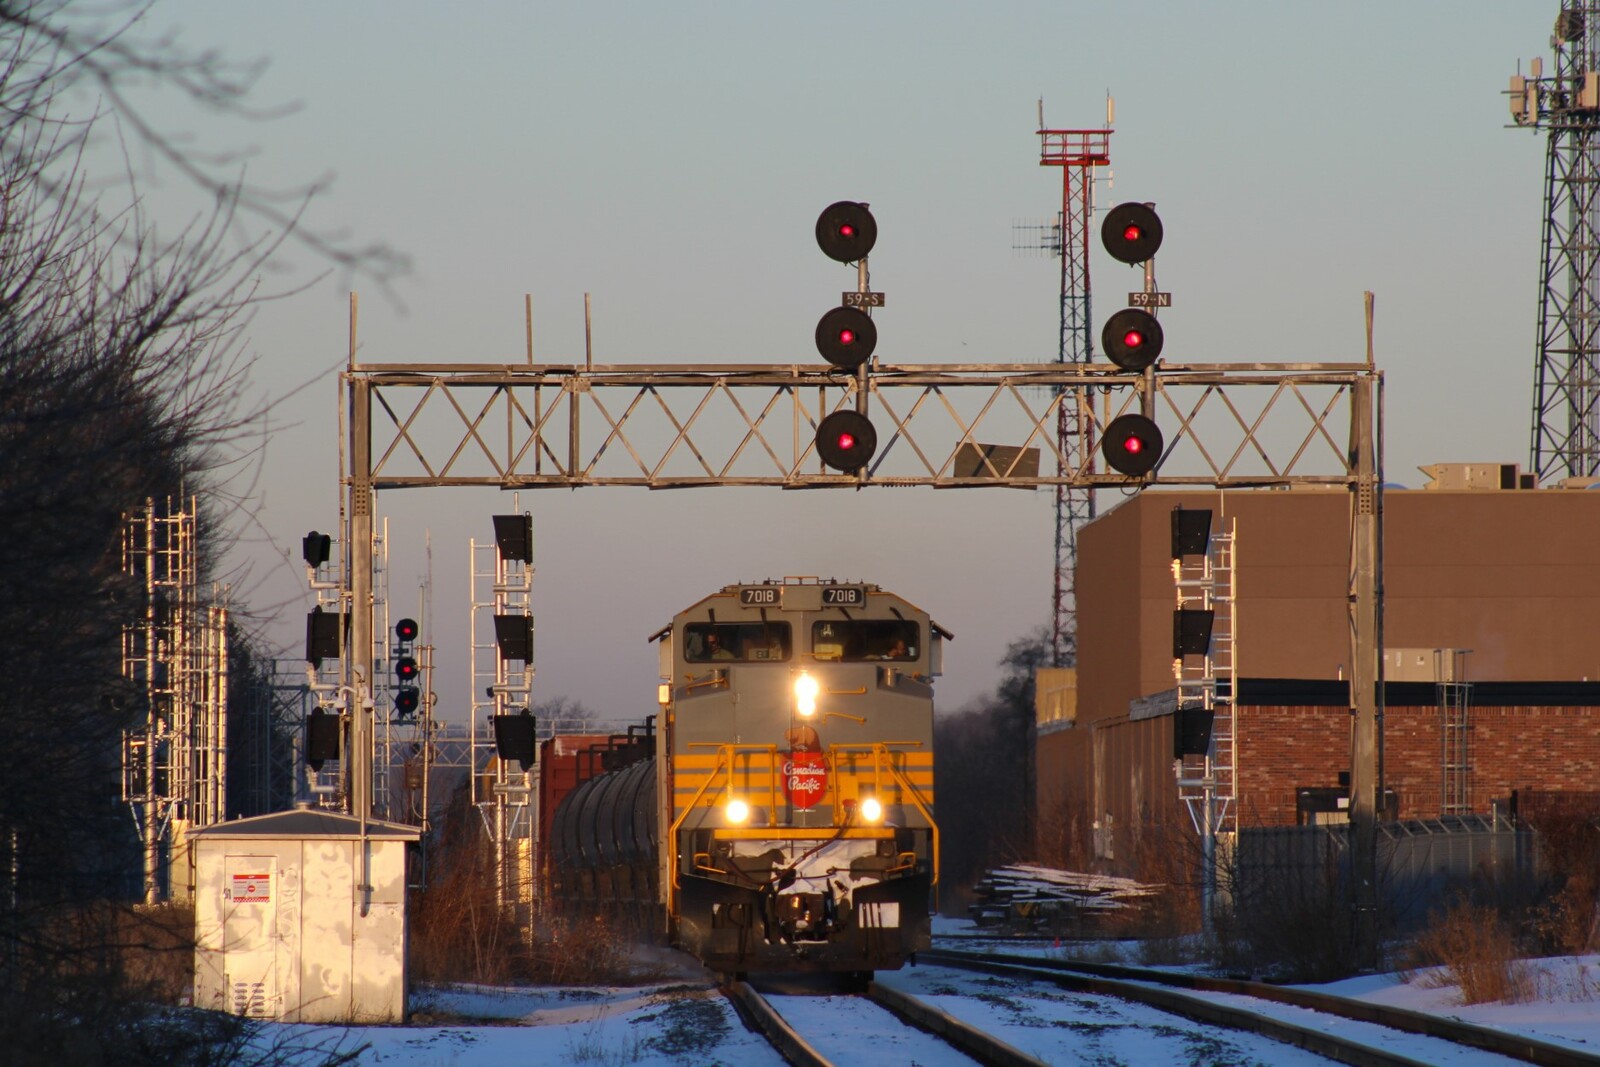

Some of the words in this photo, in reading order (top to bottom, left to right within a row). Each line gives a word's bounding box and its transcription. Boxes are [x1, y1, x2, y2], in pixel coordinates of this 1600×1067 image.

[847, 293, 879, 306] 59-S
[1133, 293, 1168, 306] 59-N
[747, 590, 774, 602] 7018
[829, 590, 856, 602] 7018
[783, 761, 825, 775] Canadian
[788, 775, 820, 794] Pacific
